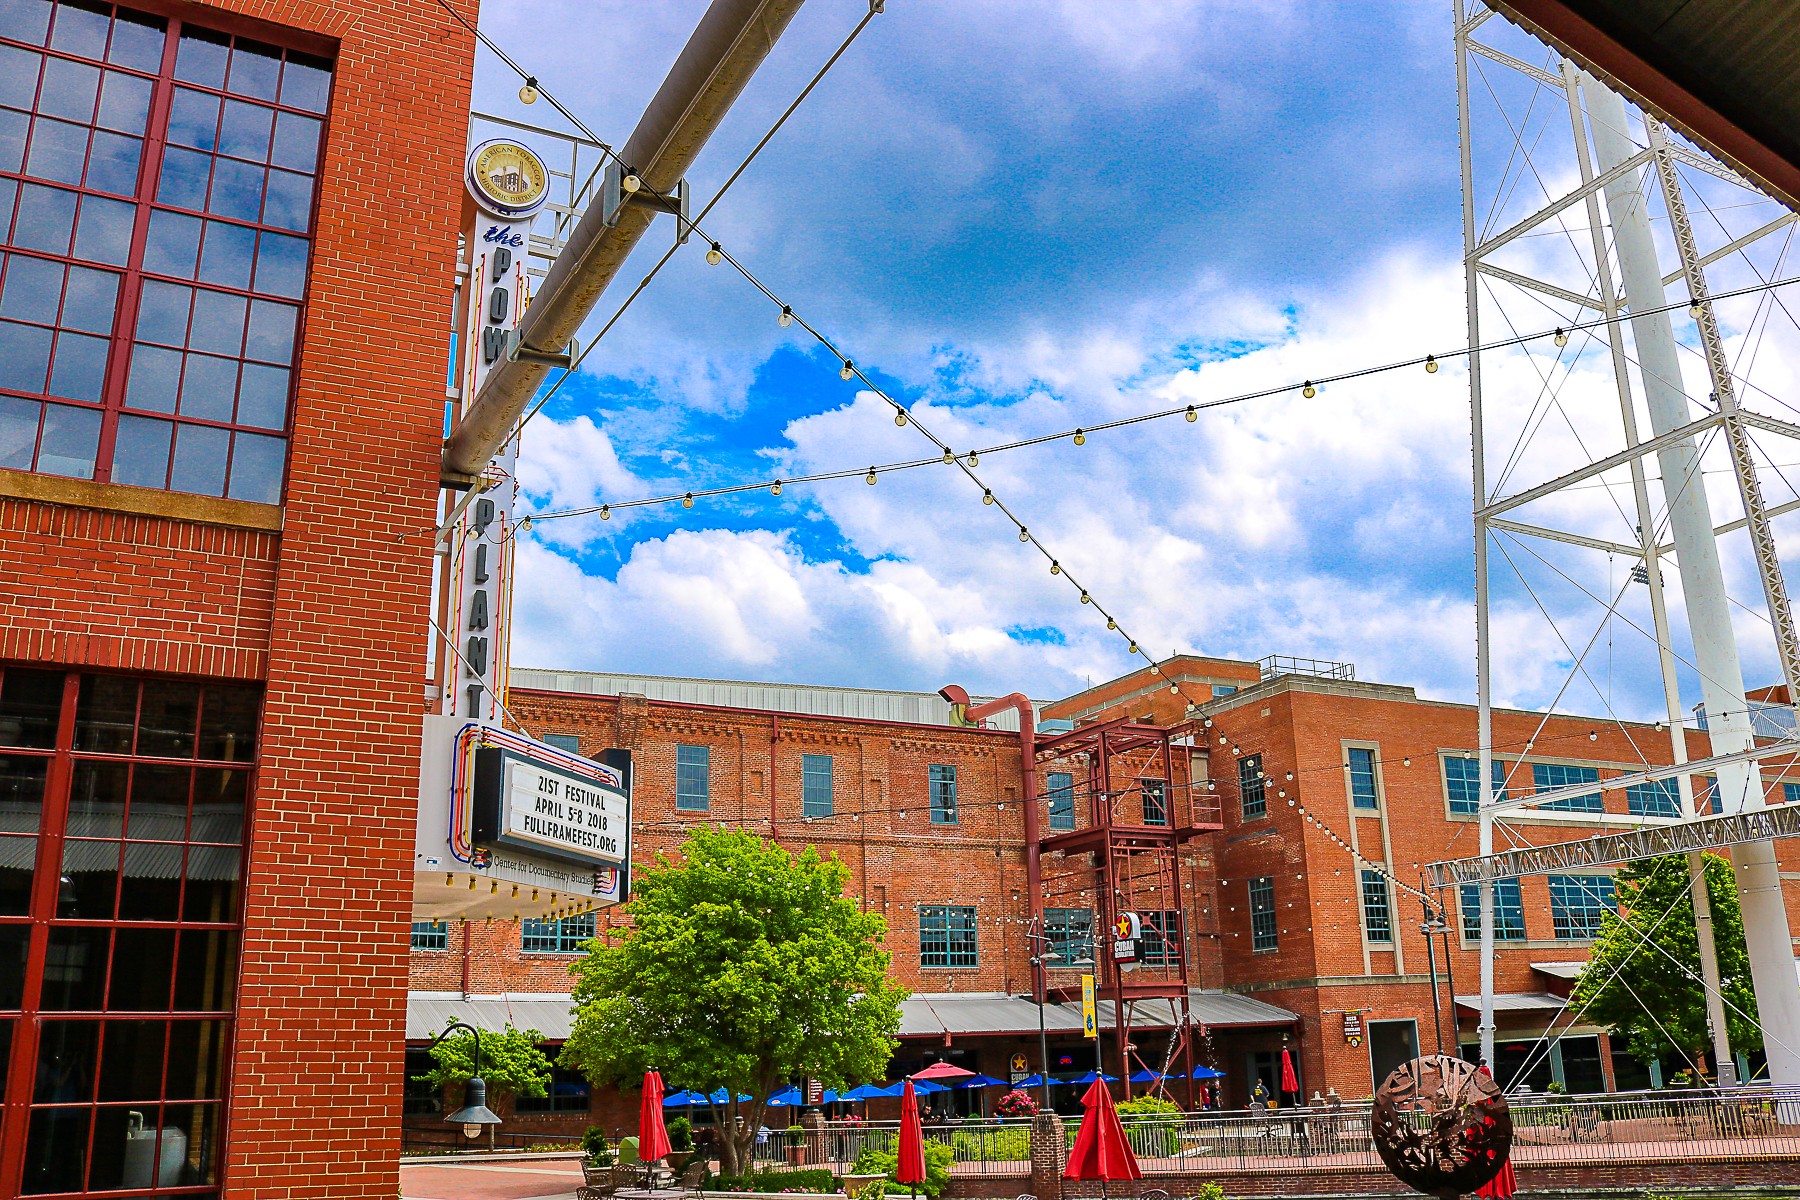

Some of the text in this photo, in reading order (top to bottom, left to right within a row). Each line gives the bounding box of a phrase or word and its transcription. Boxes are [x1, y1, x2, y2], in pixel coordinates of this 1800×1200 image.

[480, 147, 541, 181] AMERICAN TOBACCO
[481, 177, 537, 202] HISTORIC DISTRICT
[483, 225, 523, 247] the
[483, 246, 512, 364] POW
[538, 775, 606, 811] 21ST FESTIVAL
[535, 796, 563, 819] APRIL
[587, 812, 608, 831] 2018
[524, 814, 617, 853] FULLFRAMEFEST.ORG
[493, 856, 595, 886] Center for Documentary Studies
[1114, 939, 1134, 952] CUBAN
